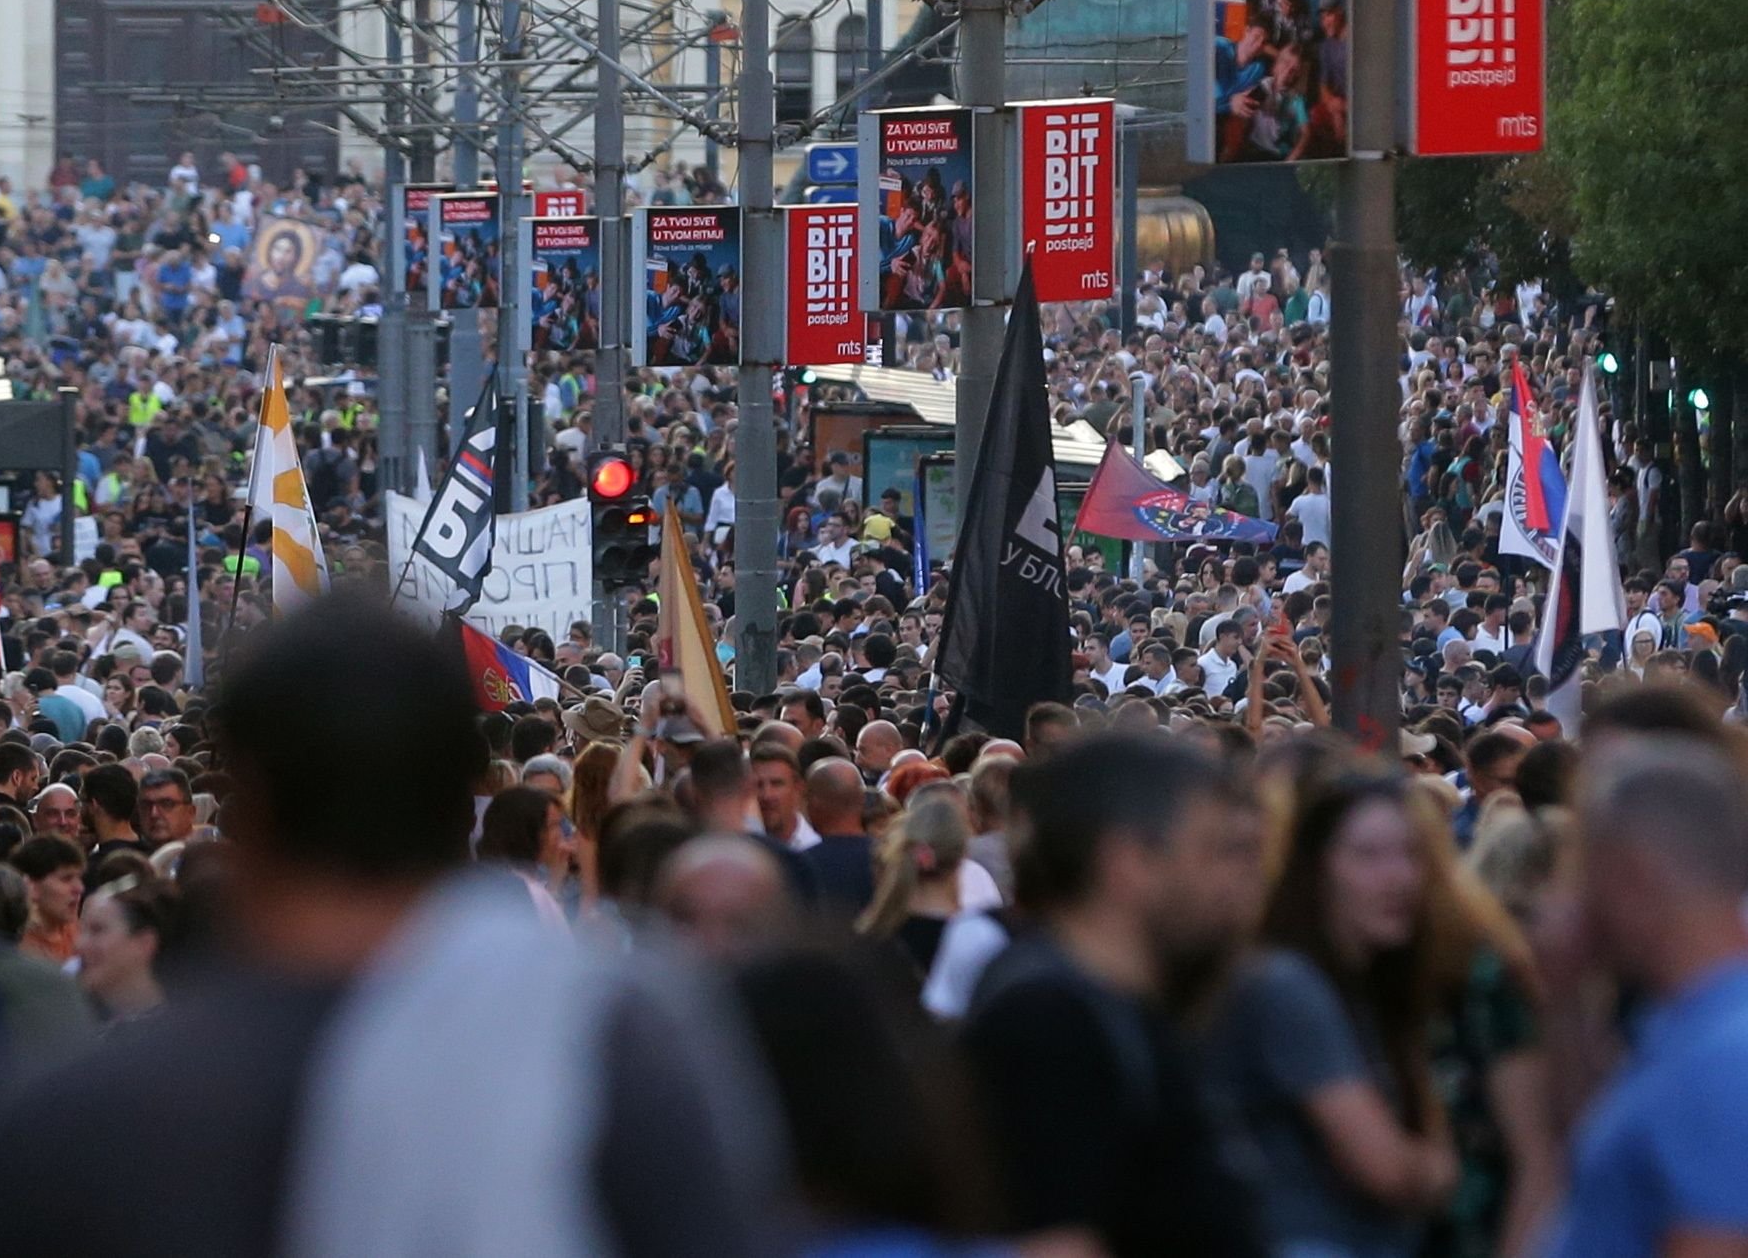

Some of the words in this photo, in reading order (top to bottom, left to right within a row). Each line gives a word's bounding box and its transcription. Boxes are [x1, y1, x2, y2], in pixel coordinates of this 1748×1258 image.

[1447, 65, 1516, 87] postpejd
[887, 124, 901, 135] ZA
[903, 123, 927, 135] TVOJ
[928, 122, 951, 134] SVET
[1498, 112, 1537, 137] mts
[887, 141, 895, 152] U
[897, 140, 926, 151] TVOM
[1046, 156, 1099, 199] BIT
[653, 217, 667, 227] ZA
[668, 216, 692, 227] TVOJ
[693, 216, 716, 226] SVET
[653, 230, 661, 240] U
[663, 230, 692, 240] TVOM
[1045, 235, 1094, 253] postpejd
[807, 249, 853, 283] BIT
[1081, 270, 1109, 289] mts
[807, 313, 848, 326] postpejd
[837, 340, 861, 355] mts
